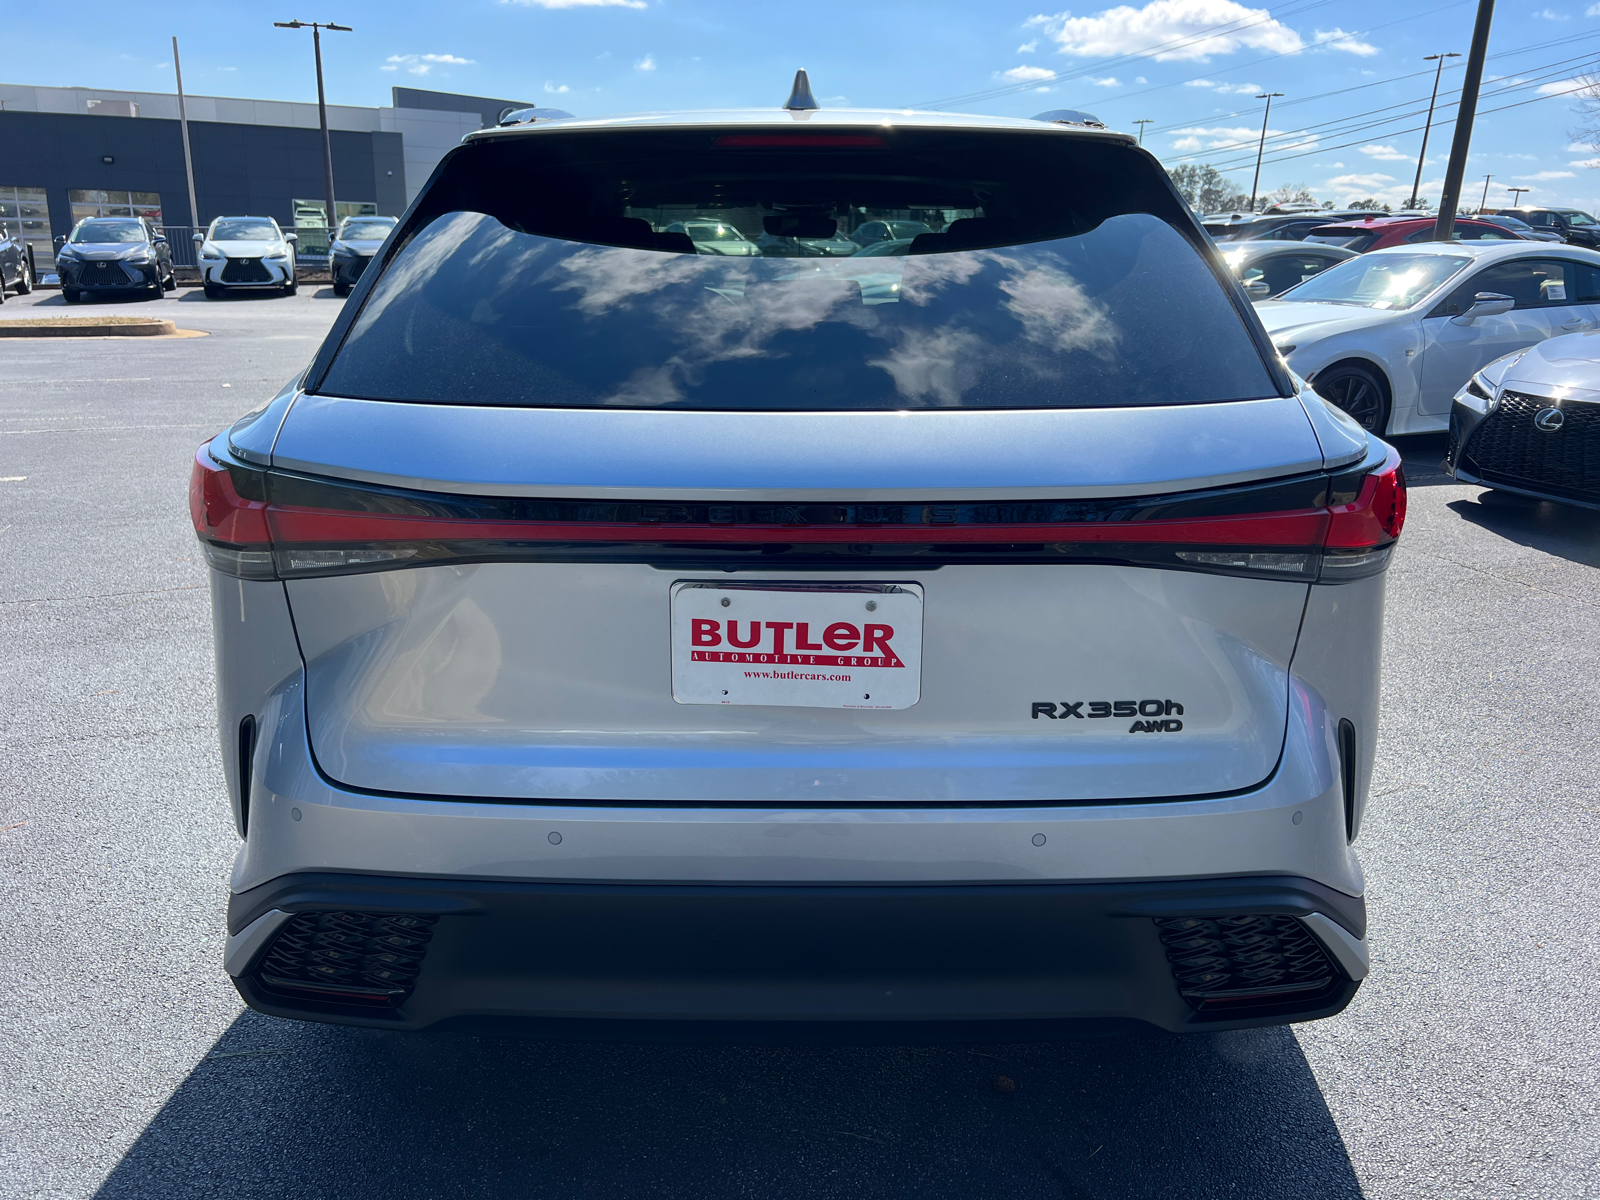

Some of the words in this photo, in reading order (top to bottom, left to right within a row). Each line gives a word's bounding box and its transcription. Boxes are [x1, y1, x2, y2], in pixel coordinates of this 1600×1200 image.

[692, 652, 815, 664] AUTOMOTIVE
[837, 656, 898, 667] GROUP
[744, 669, 852, 682] www.butlercars.com
[1128, 719, 1183, 734] AWD
